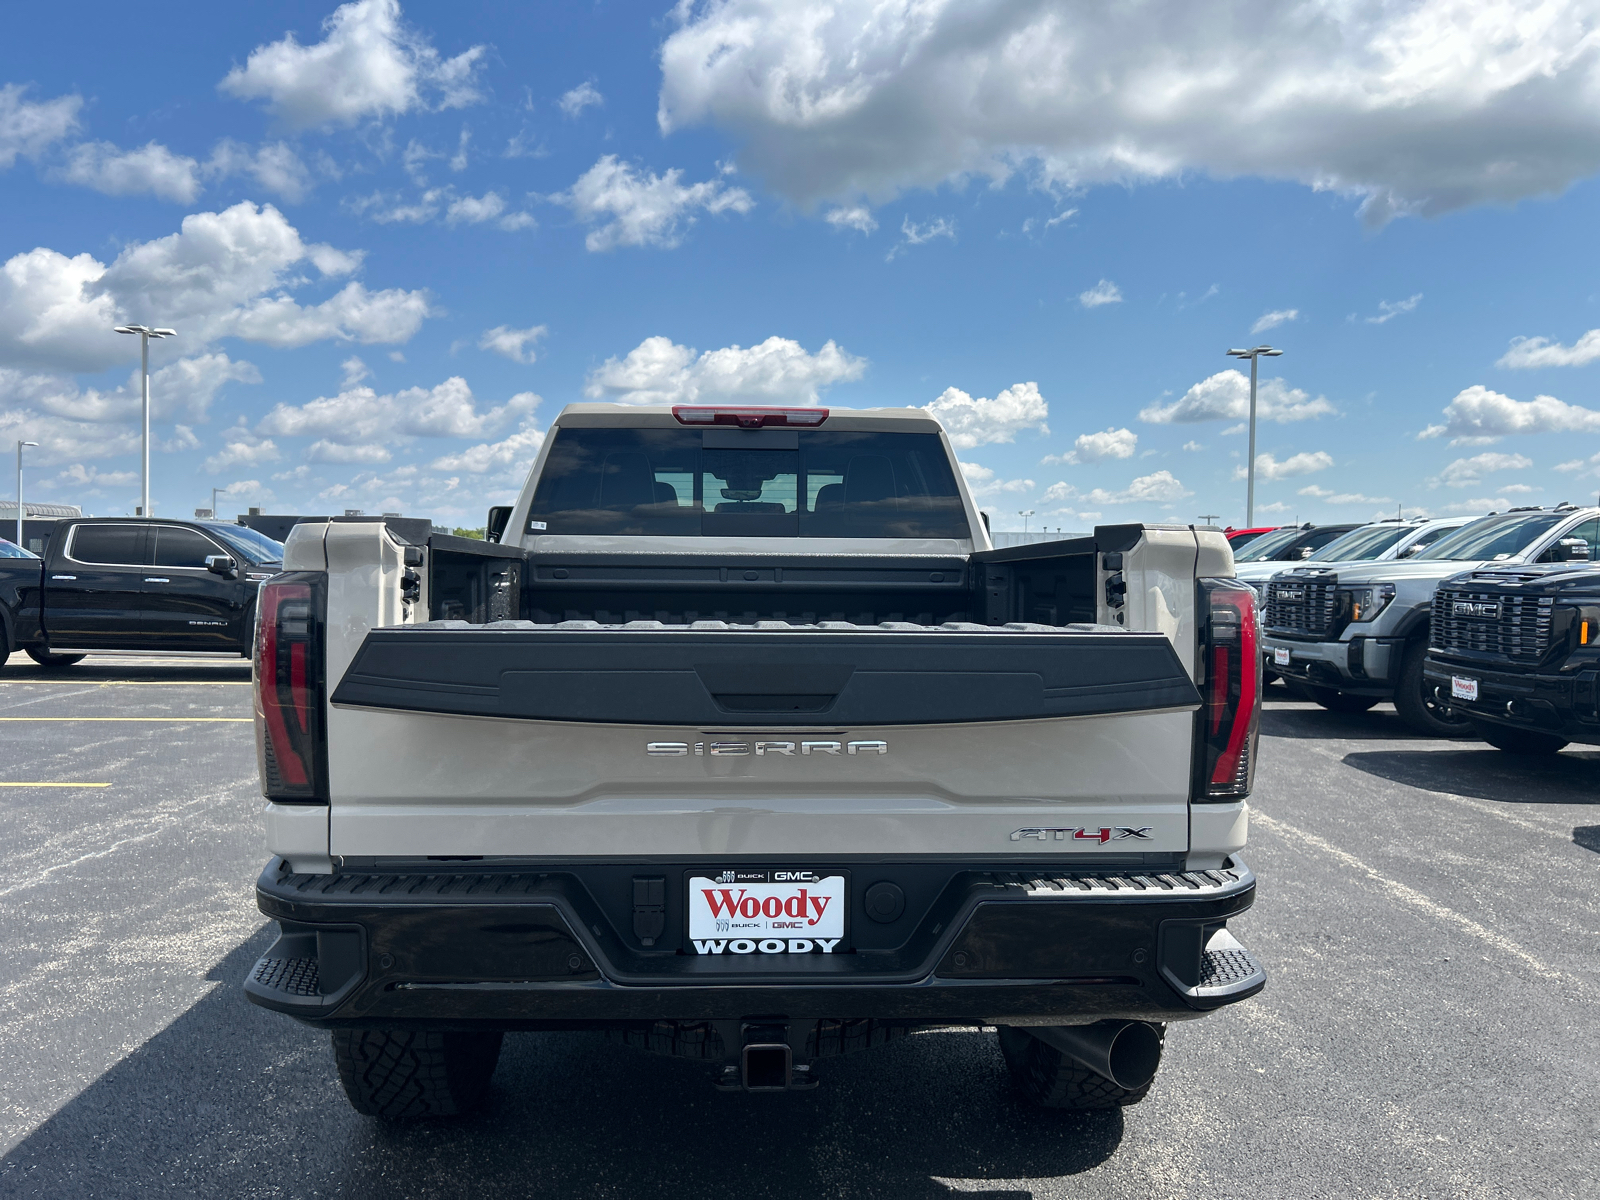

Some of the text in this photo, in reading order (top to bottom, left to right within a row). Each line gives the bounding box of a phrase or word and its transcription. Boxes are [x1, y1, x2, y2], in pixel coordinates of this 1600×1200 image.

[1453, 602, 1498, 618] GMC
[1454, 679, 1475, 693] Woody
[647, 740, 888, 757] SIERRA
[1010, 826, 1154, 845] AT4X
[774, 871, 813, 881] GMC
[701, 888, 832, 926] Woody
[772, 921, 803, 929] GMC
[692, 939, 841, 955] WOODY
